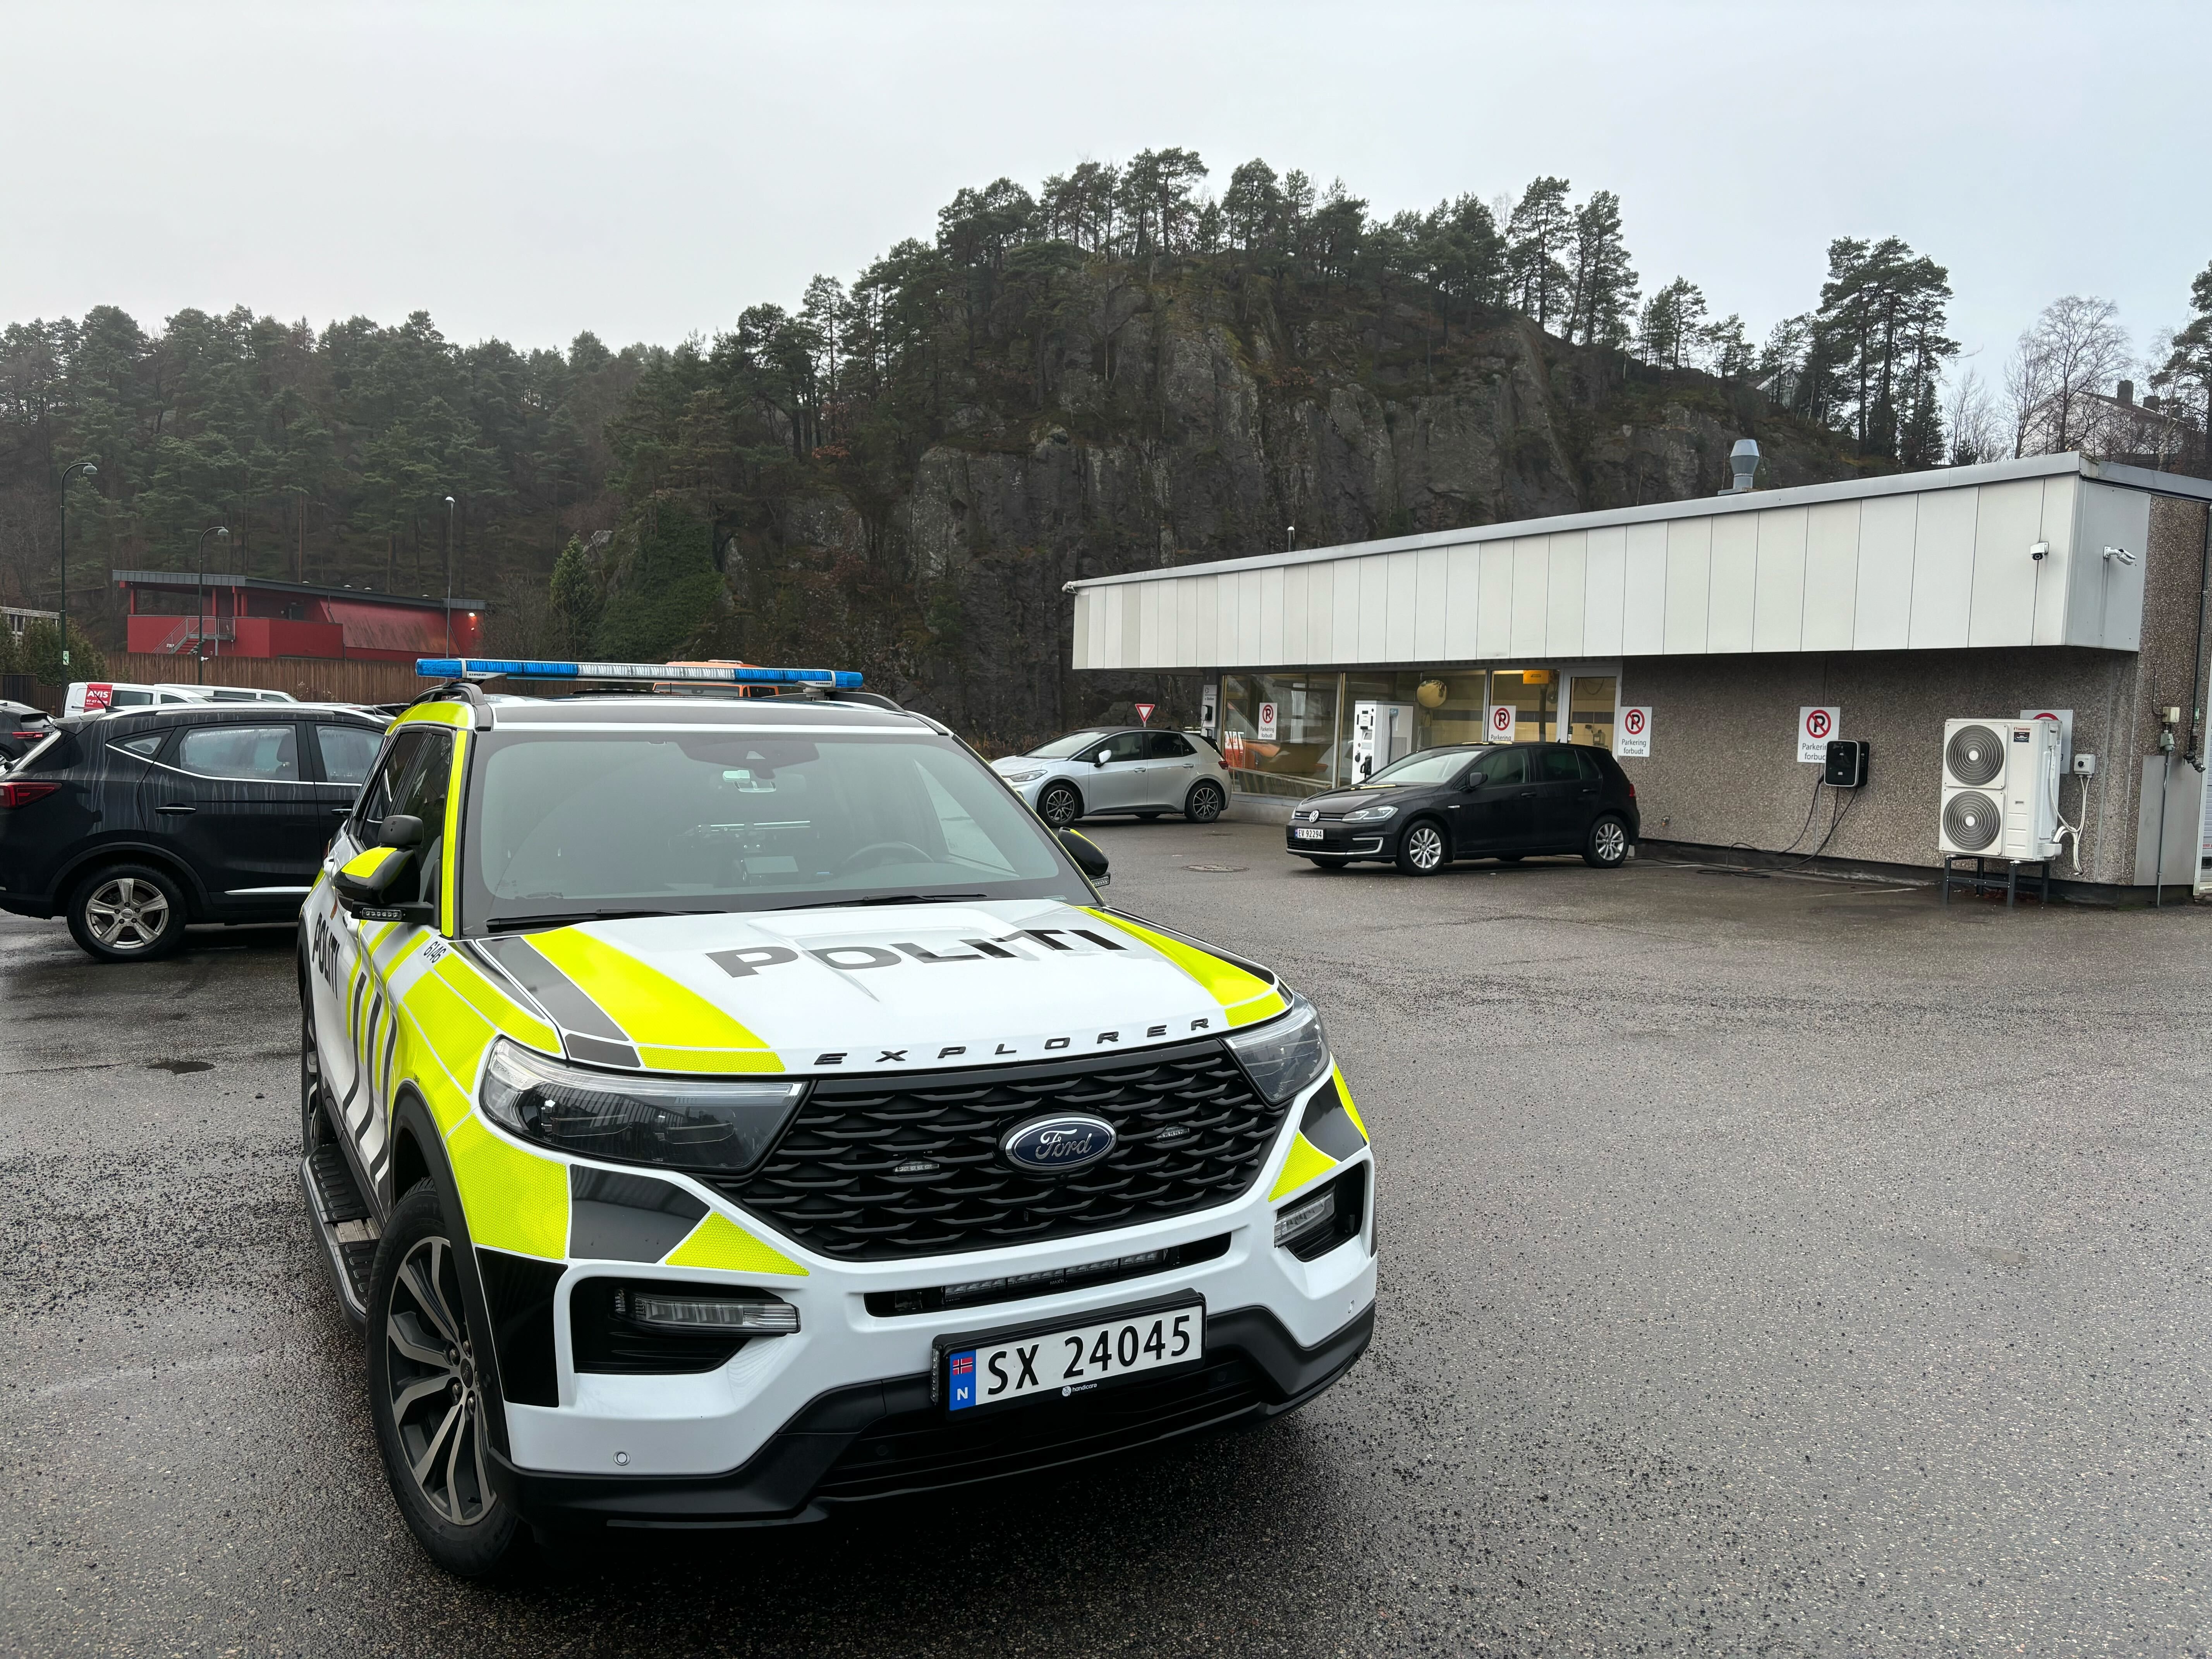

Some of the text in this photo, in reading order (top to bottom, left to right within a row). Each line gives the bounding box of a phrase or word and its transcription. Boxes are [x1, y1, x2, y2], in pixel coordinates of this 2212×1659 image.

[1621, 739, 1646, 747] Parkering
[312, 912, 340, 1001] POLITI
[424, 941, 447, 963] 6146
[705, 929, 1129, 978] POLITI
[814, 1018, 1210, 1066] EXPLORER
[1035, 1128, 1092, 1159] Ford
[988, 1314, 1190, 1395] SX 24045
[957, 1387, 968, 1400] N
